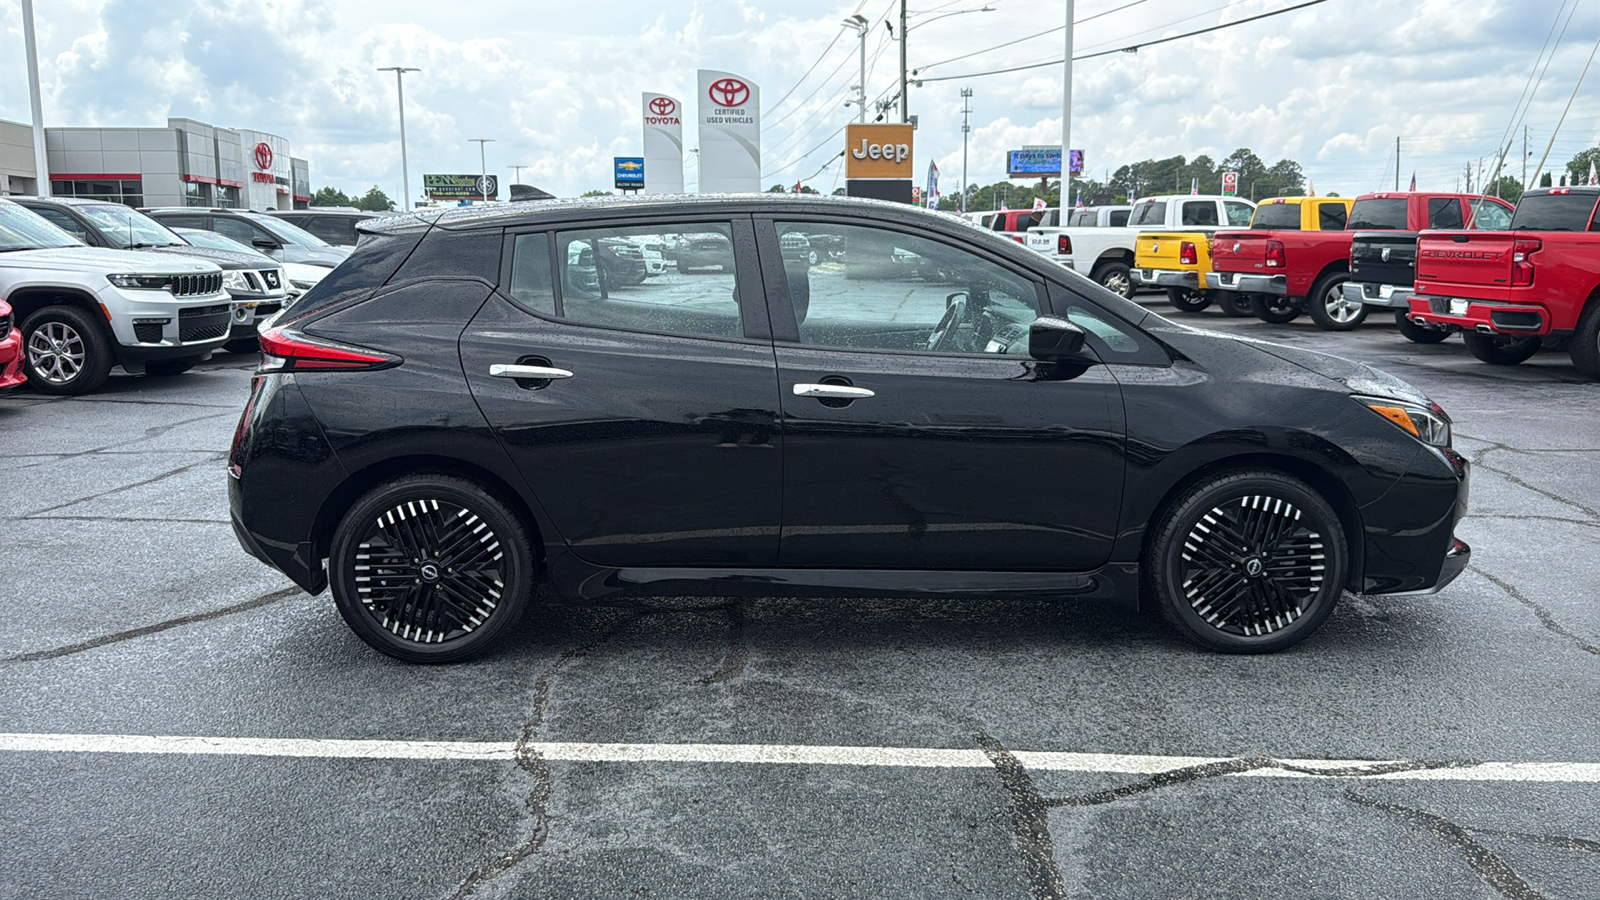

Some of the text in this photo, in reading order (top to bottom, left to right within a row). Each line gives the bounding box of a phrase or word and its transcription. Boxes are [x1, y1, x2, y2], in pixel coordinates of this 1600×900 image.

[645, 117, 680, 125] TOYOTA
[853, 139, 909, 164] Jeep
[253, 172, 275, 183] TOYOTA
[426, 175, 455, 185] PENN
[1421, 250, 1503, 260] CHEVROLET
